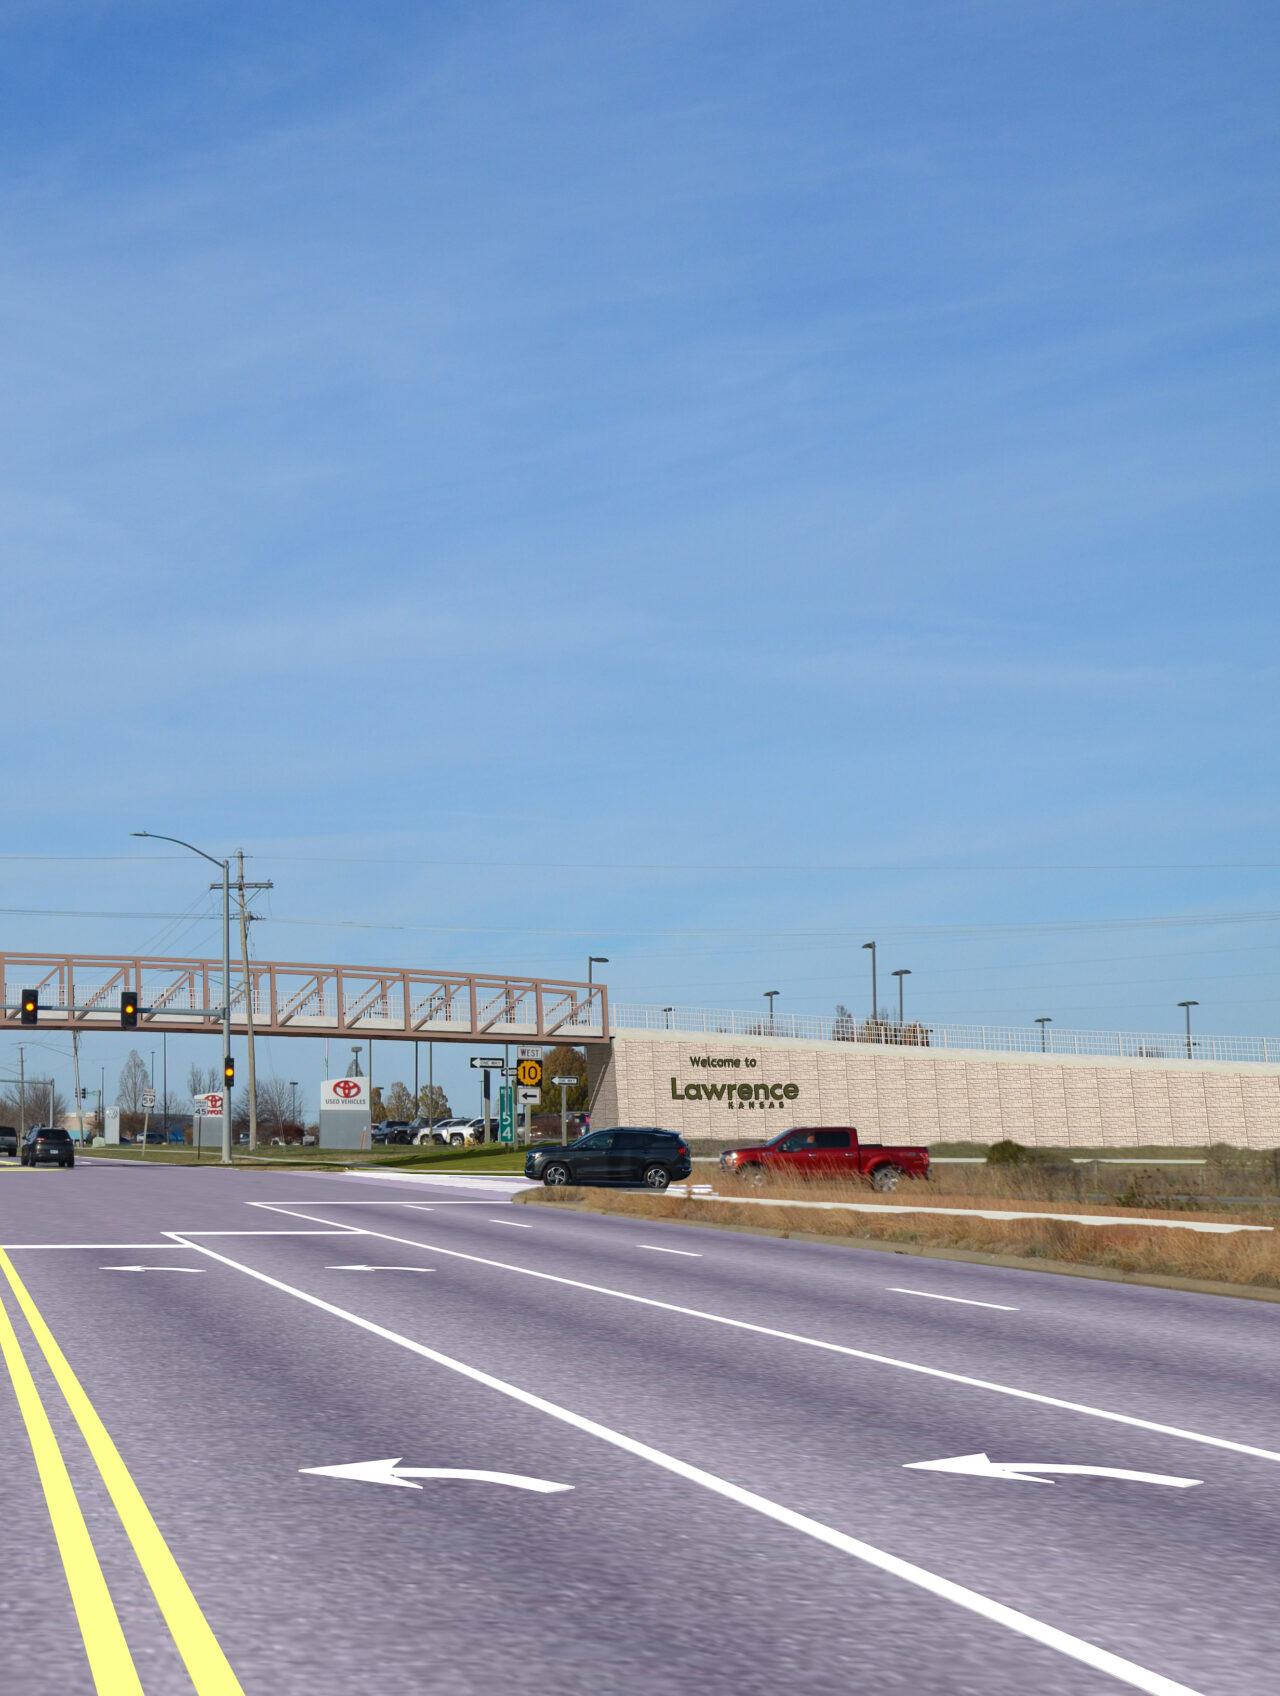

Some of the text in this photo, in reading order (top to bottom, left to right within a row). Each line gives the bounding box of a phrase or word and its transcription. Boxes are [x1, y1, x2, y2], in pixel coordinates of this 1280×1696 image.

[520, 1048, 539, 1057] WEST
[689, 1056, 757, 1068] Welcome to
[522, 1066, 538, 1080] 10
[670, 1077, 800, 1101] Lawrence
[143, 1096, 154, 1105] 59
[728, 1101, 785, 1109] KANSAS
